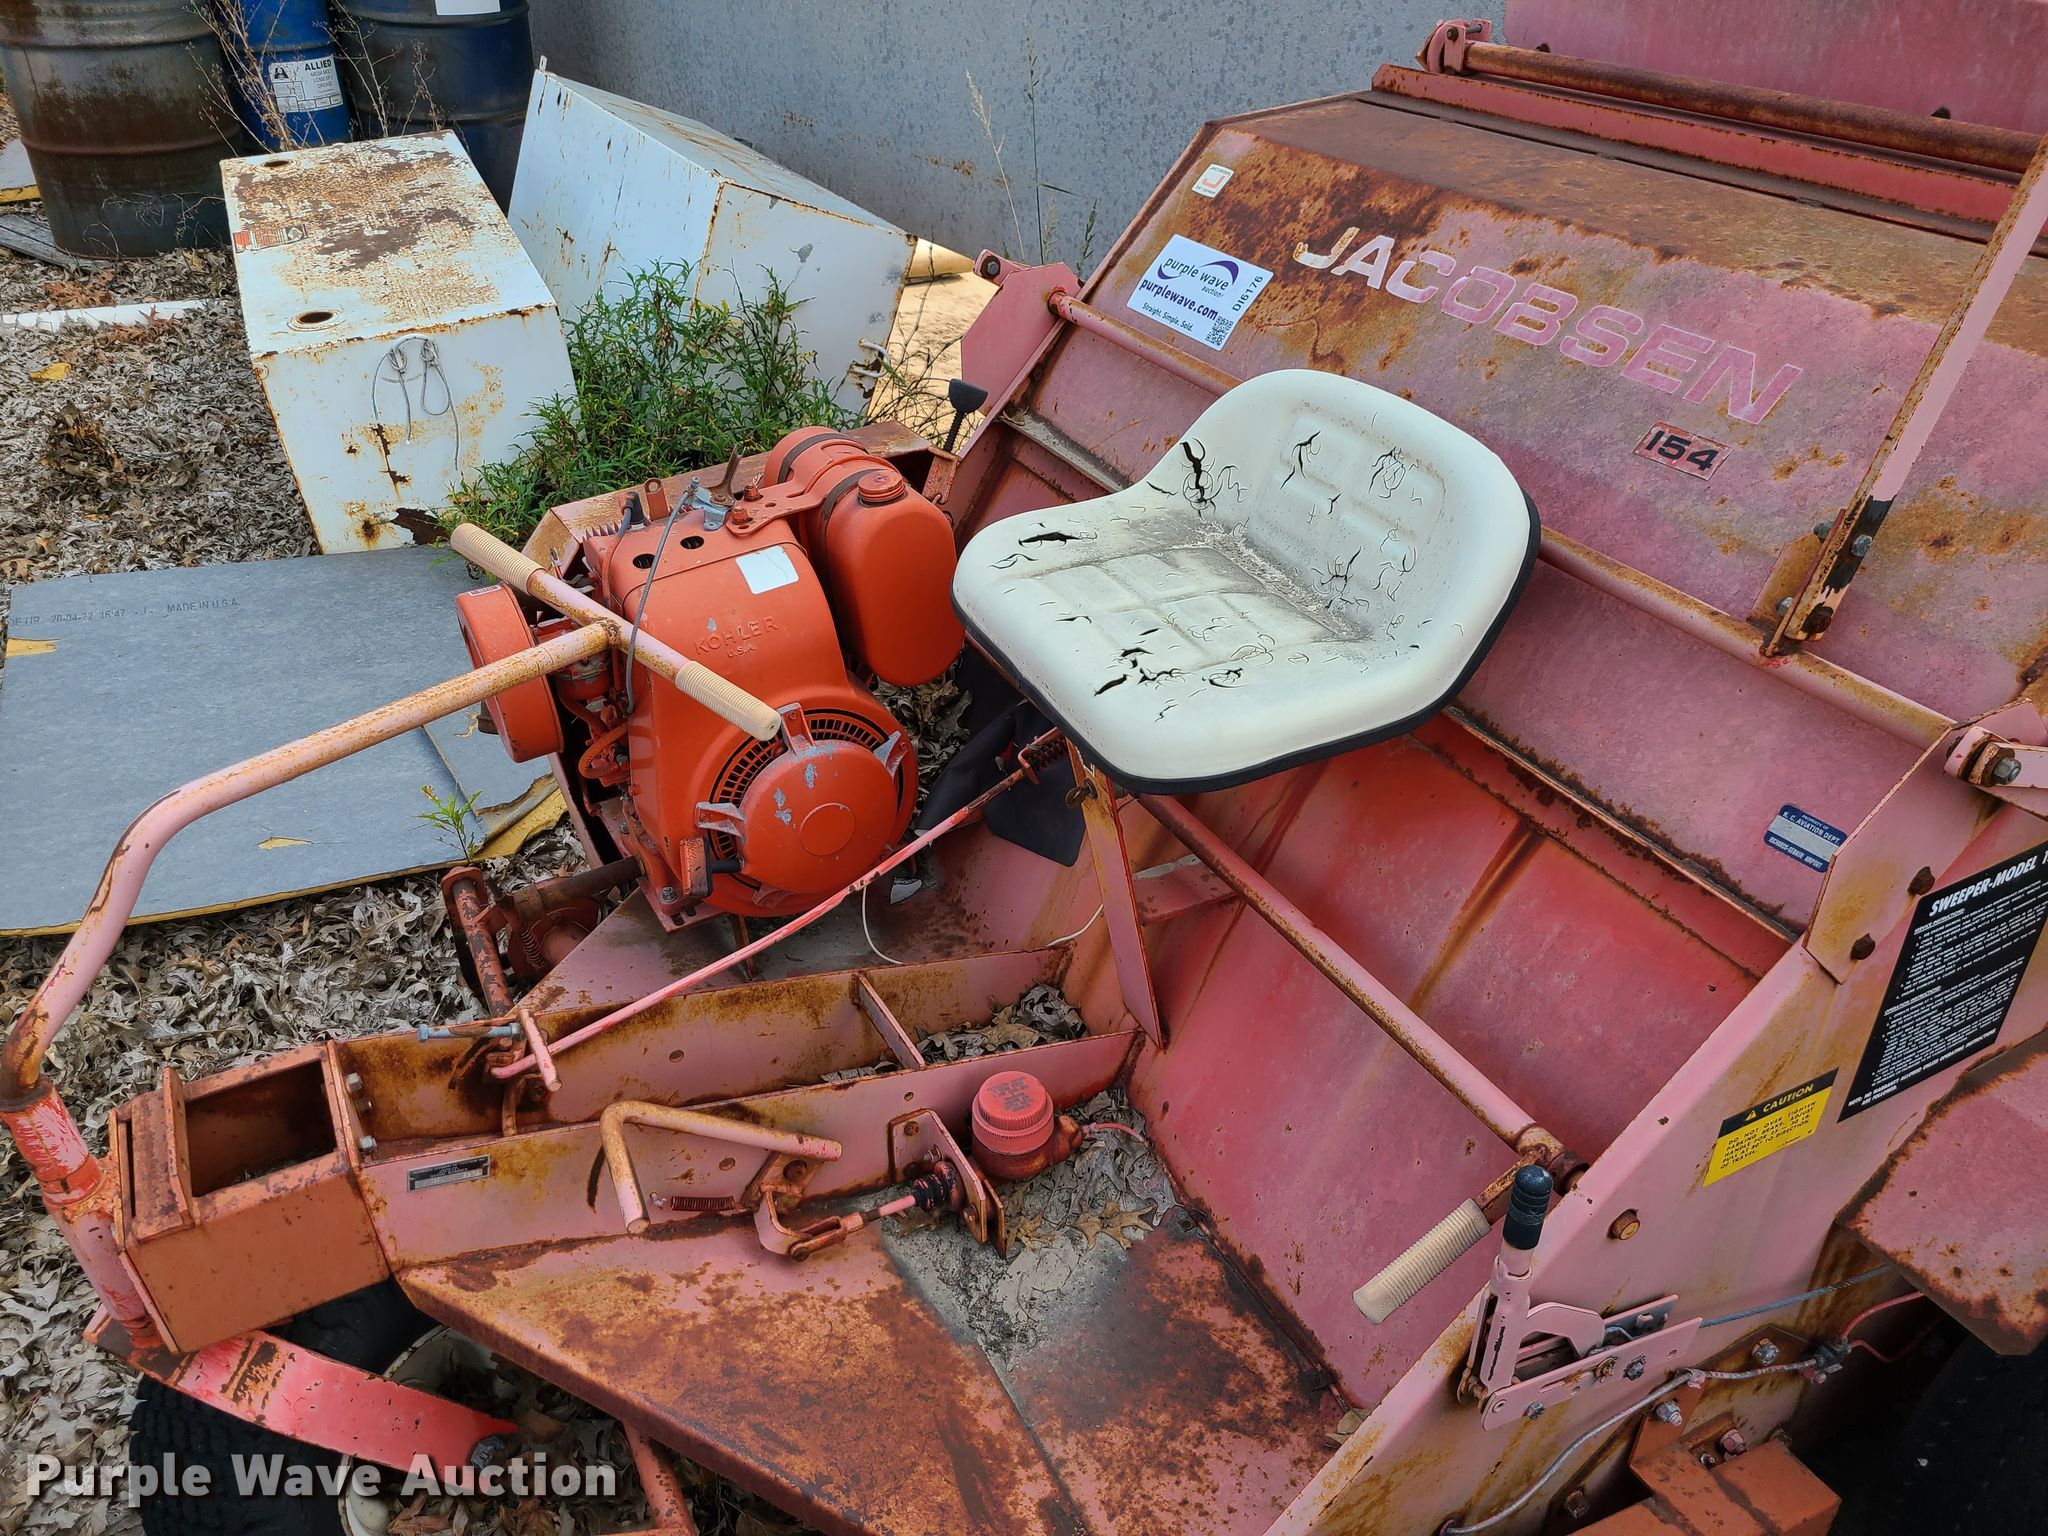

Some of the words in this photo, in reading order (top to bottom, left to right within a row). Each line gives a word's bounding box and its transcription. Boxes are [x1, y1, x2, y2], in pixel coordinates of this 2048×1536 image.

[305, 59, 332, 71] ALLIED
[1163, 258, 1199, 278] purple
[1200, 272, 1229, 291] wave
[1139, 279, 1218, 321] purplewave.com
[1232, 276, 1263, 312] DI6176
[1162, 311, 1180, 326] Simple.
[1293, 226, 1803, 425] JACOBSEN
[1645, 430, 1719, 471] 154
[167, 601, 196, 613] MADE
[694, 616, 779, 656] KOHLER
[1796, 818, 1822, 836] AVIATION
[1823, 831, 1841, 846] DEPT.
[1804, 855, 1823, 869] AIRPORT
[1929, 855, 2037, 916] SWEEPER-MODEL
[1762, 1084, 1814, 1112] CAUTION
[1722, 1154, 1737, 1163] PULL
[1776, 1119, 1809, 1137] DIRECTION
[1726, 1134, 1757, 1151] PARKING
[1790, 1107, 1814, 1121] ADJUST
[1728, 1136, 1739, 1145] DO
[1744, 1128, 1759, 1138] NOT
[1764, 1117, 1783, 1128] OVER
[1788, 1101, 1816, 1117] TIGHTEN
[1724, 1142, 1750, 1157] HANDLE
[1754, 1134, 1767, 1143] FOR
